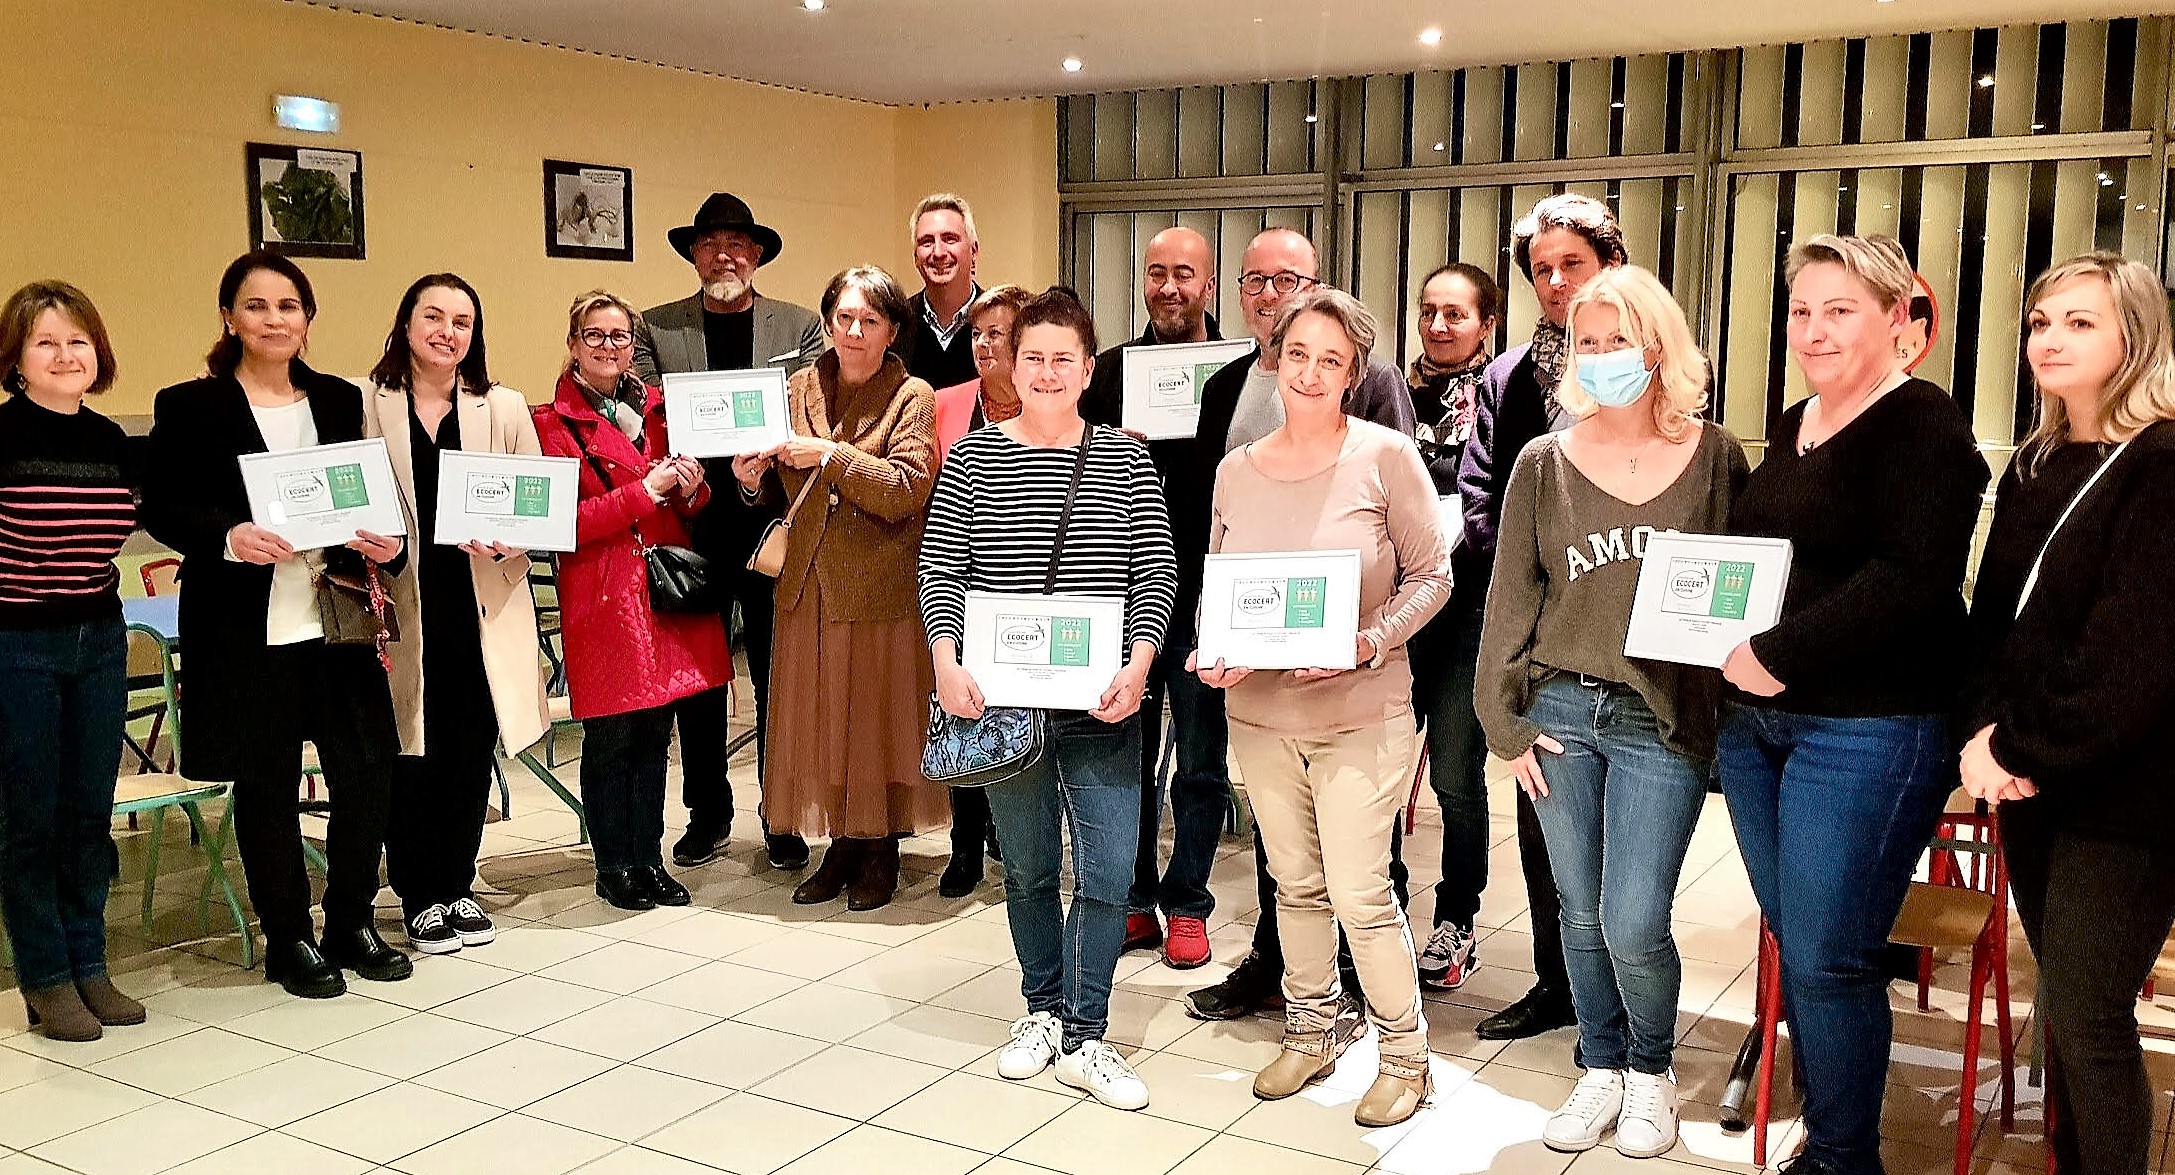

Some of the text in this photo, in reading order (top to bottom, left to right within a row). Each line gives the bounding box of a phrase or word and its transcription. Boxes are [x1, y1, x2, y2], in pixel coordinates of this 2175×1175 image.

[524, 477, 543, 485] 2022
[476, 488, 504, 496] ECOCERT
[1565, 525, 1681, 582] AMO
[1726, 563, 1746, 572] 2022
[1296, 579, 1318, 587] 2022
[1676, 579, 1704, 588] ECOCERT
[1243, 597, 1274, 605] ECOCERT
[1060, 618, 1082, 627] 2022
[1007, 633, 1039, 641] ECOCERT
